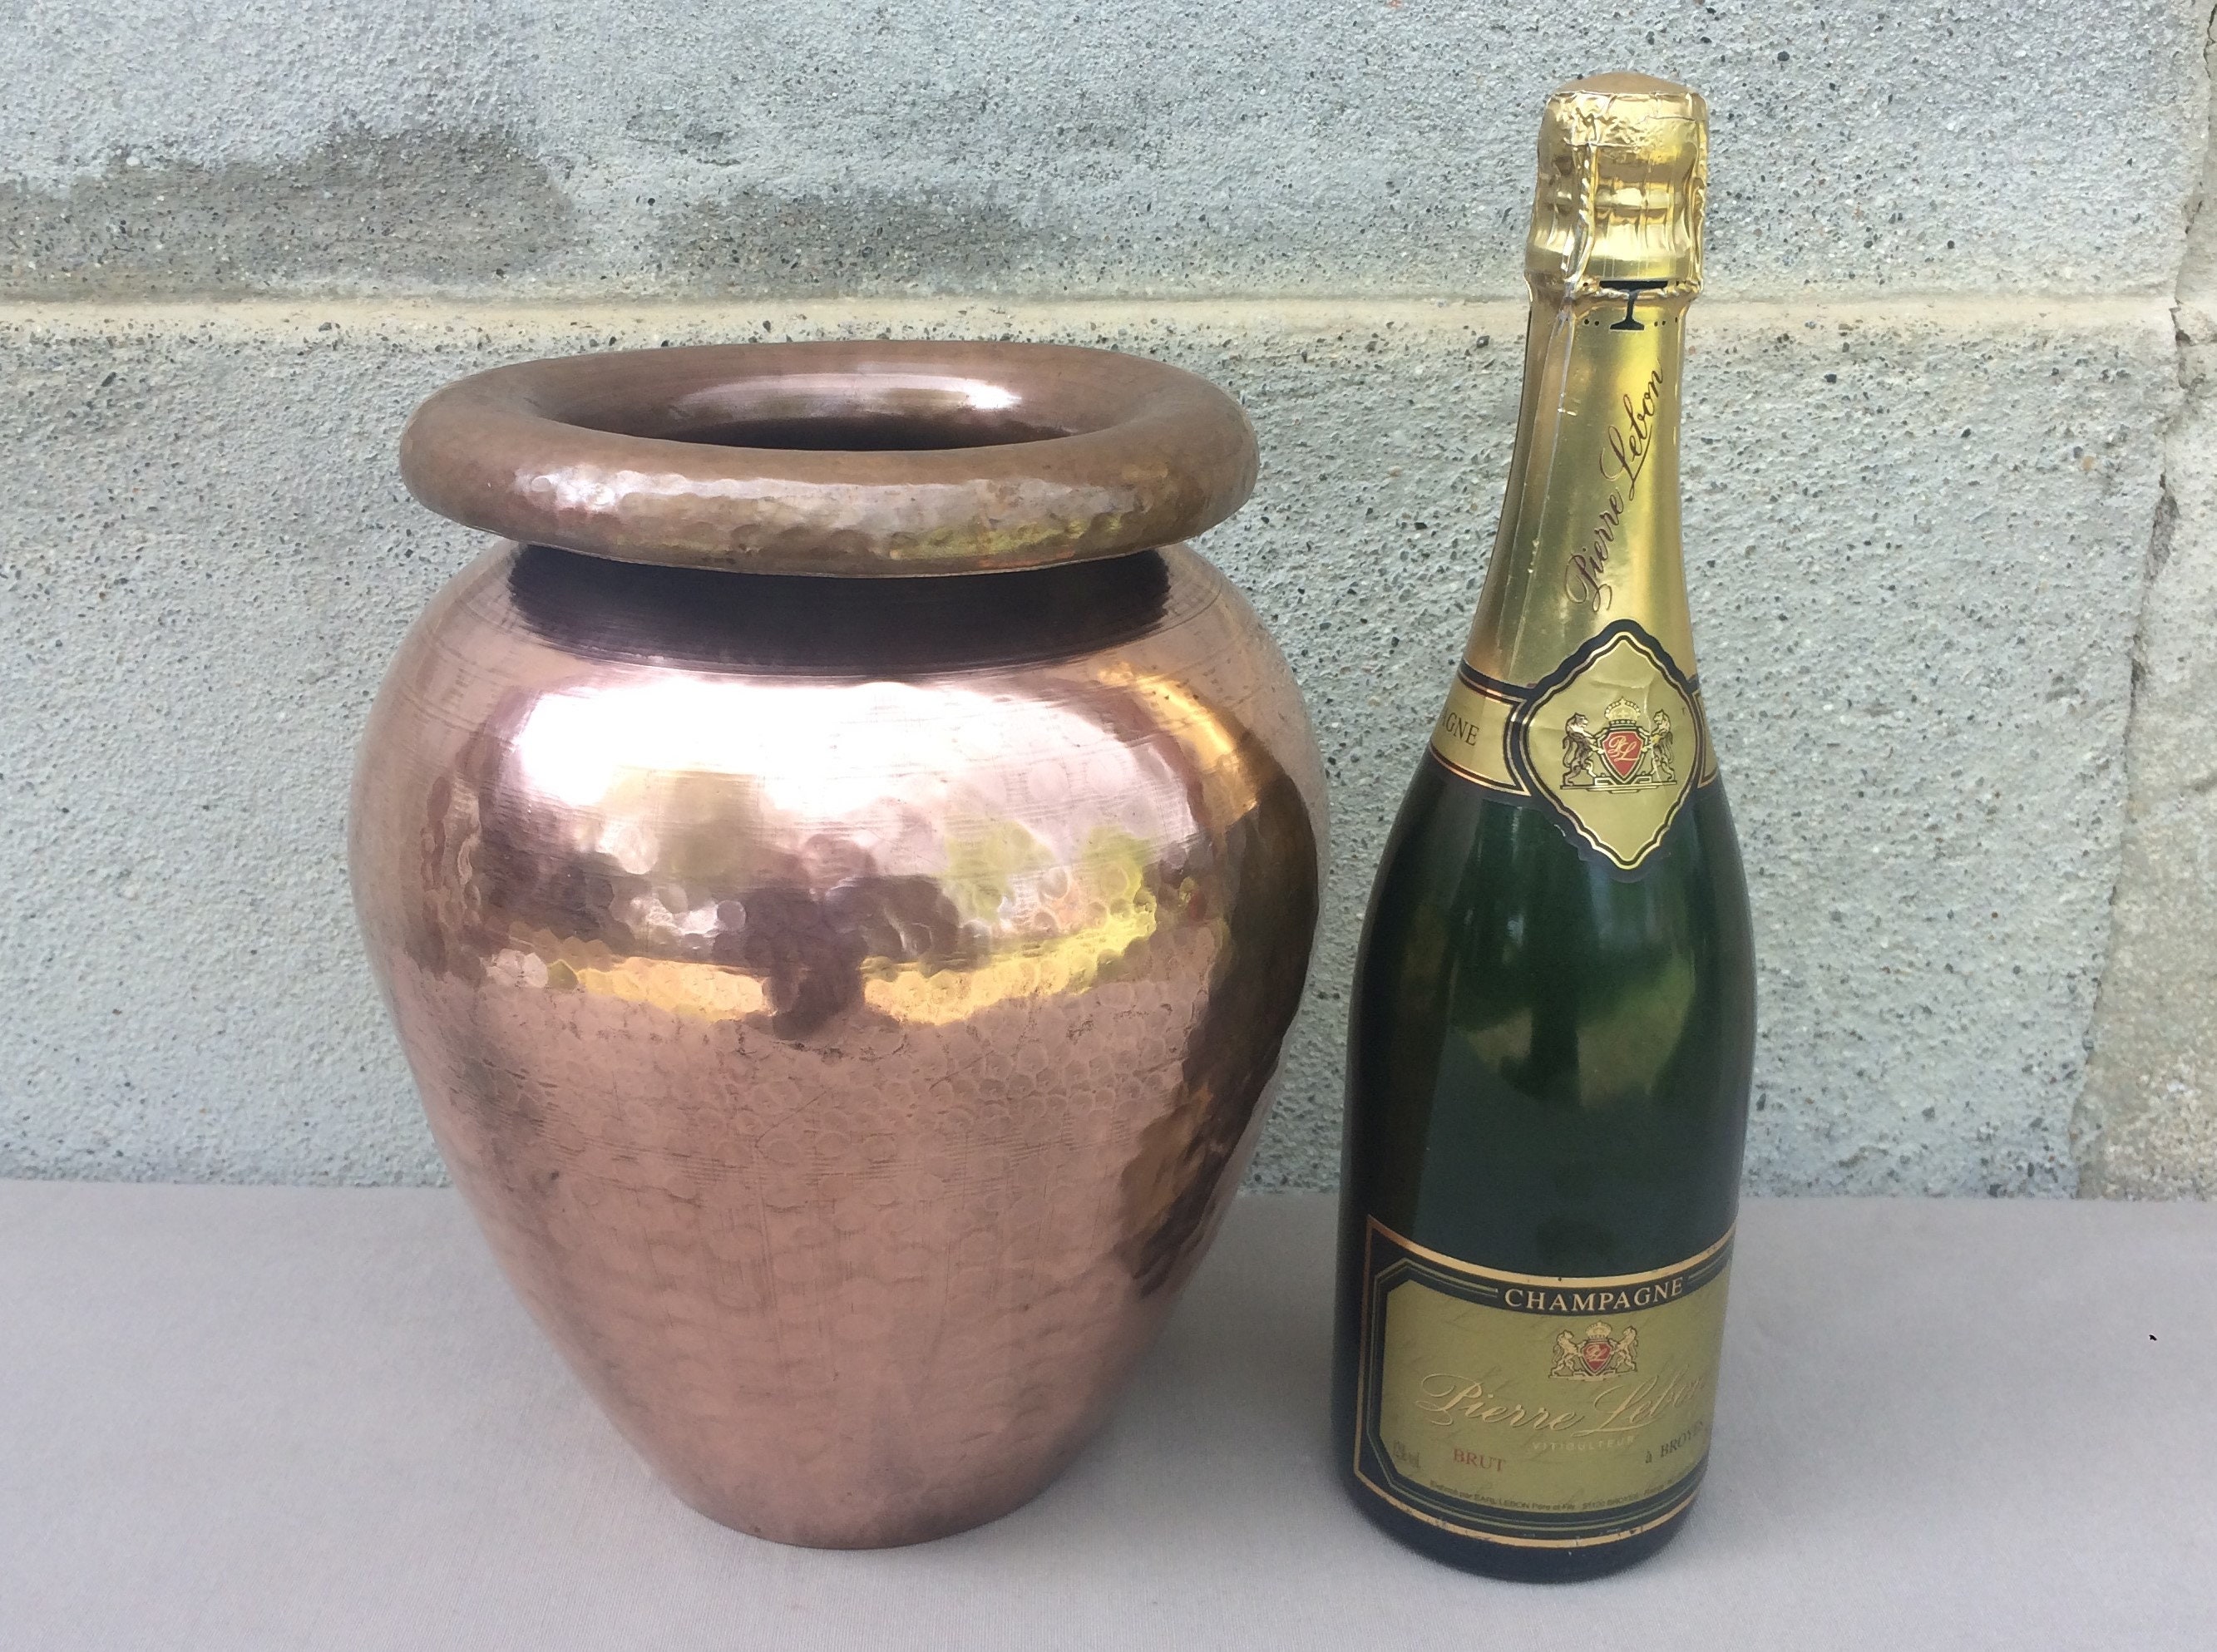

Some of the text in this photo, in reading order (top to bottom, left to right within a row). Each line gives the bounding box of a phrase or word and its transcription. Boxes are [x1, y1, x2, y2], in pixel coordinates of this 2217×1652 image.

[1564, 358, 1663, 613] Pierre Lebon
[1504, 1276, 1683, 1312] CHAMPAGNE
[1415, 1373, 1585, 1431] Pierre
[1453, 1447, 1506, 1472] BRUT
